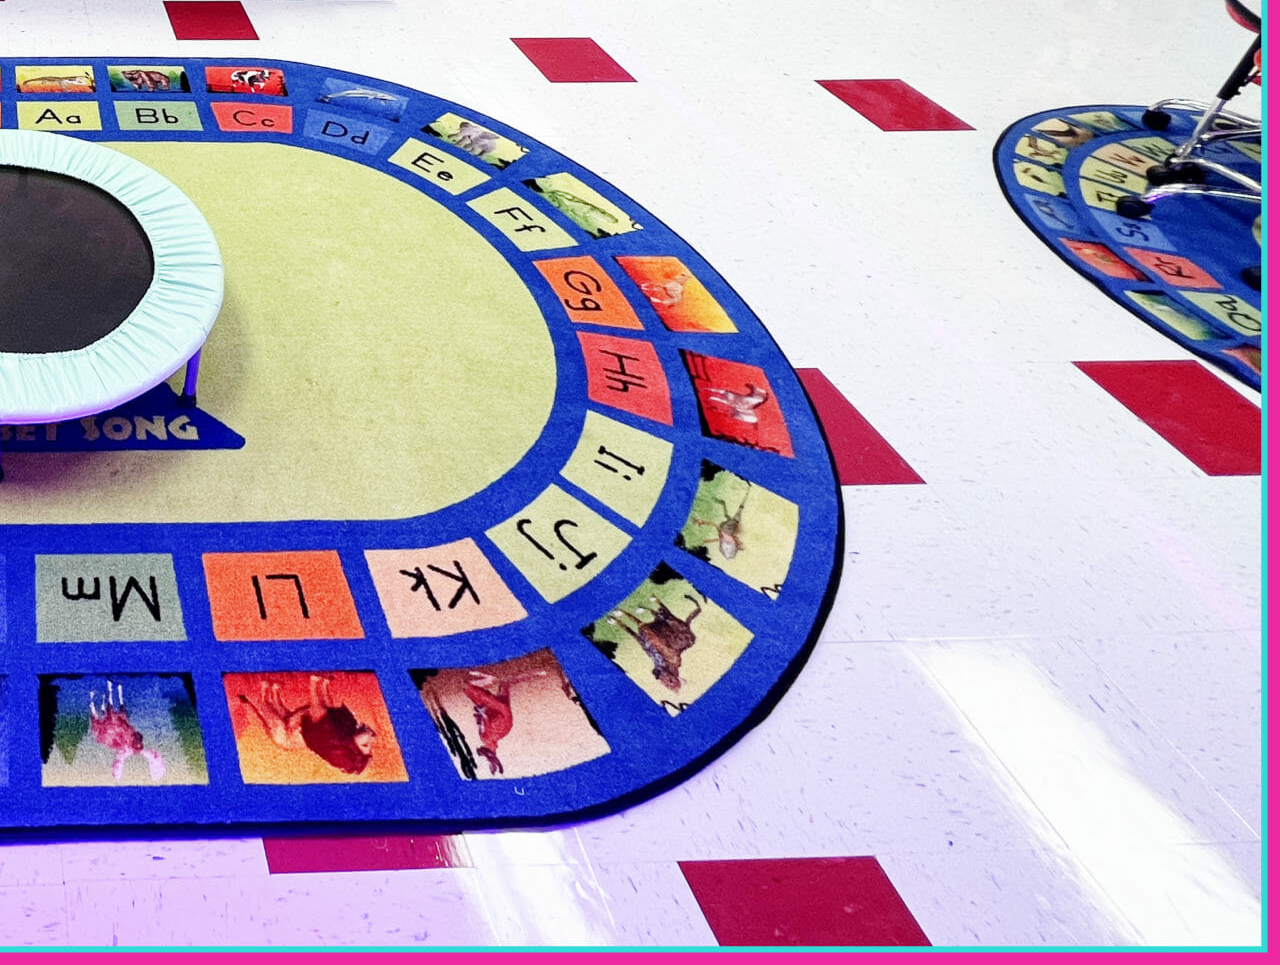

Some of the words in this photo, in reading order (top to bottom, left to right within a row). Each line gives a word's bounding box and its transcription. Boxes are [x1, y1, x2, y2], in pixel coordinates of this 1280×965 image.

[35, 108, 82, 126] Aa
[136, 107, 180, 126] Bb
[231, 110, 276, 128] Cc
[320, 120, 369, 146] Dd
[410, 150, 454, 183] Ee
[493, 205, 547, 237] Ff
[563, 269, 602, 312] Gg
[599, 348, 648, 394] Hh
[80, 415, 200, 442] SONG
[593, 445, 646, 482] Ii
[516, 518, 598, 571] Jj
[61, 575, 162, 623] Mm
[251, 573, 310, 621] Ll
[399, 560, 482, 612] Kk
